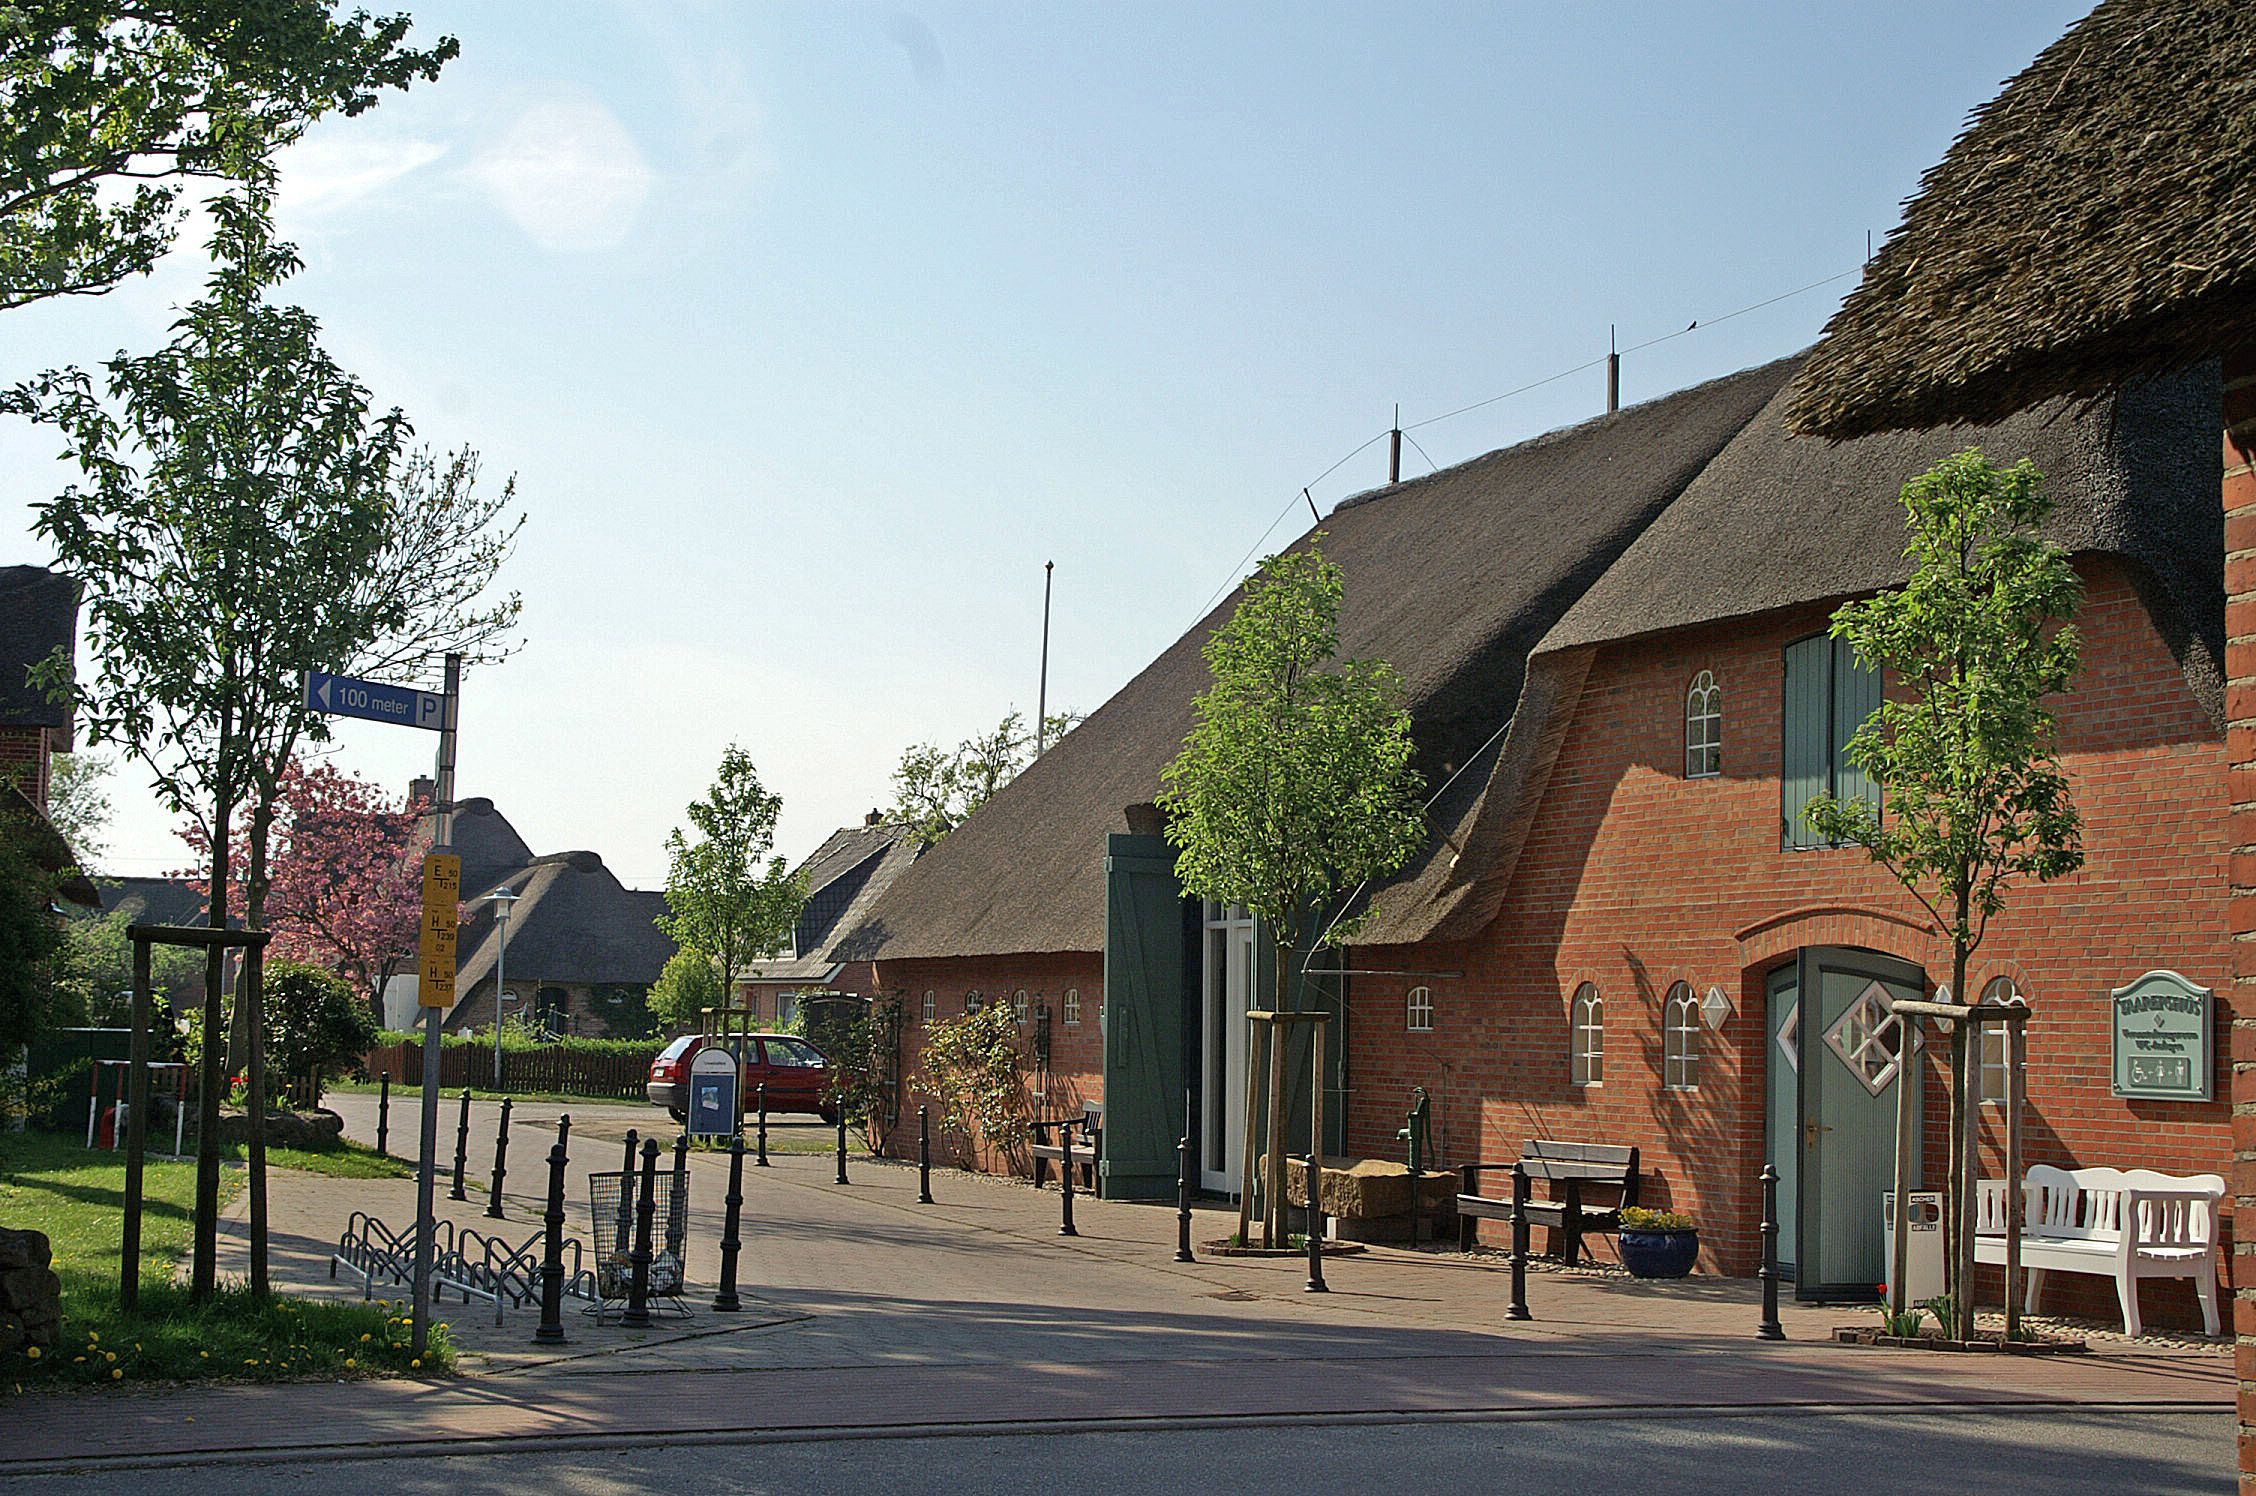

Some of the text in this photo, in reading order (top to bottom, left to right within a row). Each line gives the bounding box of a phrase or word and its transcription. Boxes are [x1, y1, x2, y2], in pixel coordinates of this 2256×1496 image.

[339, 687, 437, 722] 100 meter P
[434, 865, 458, 877] E 50
[431, 915, 456, 928] H 50
[429, 967, 453, 978] H 50
